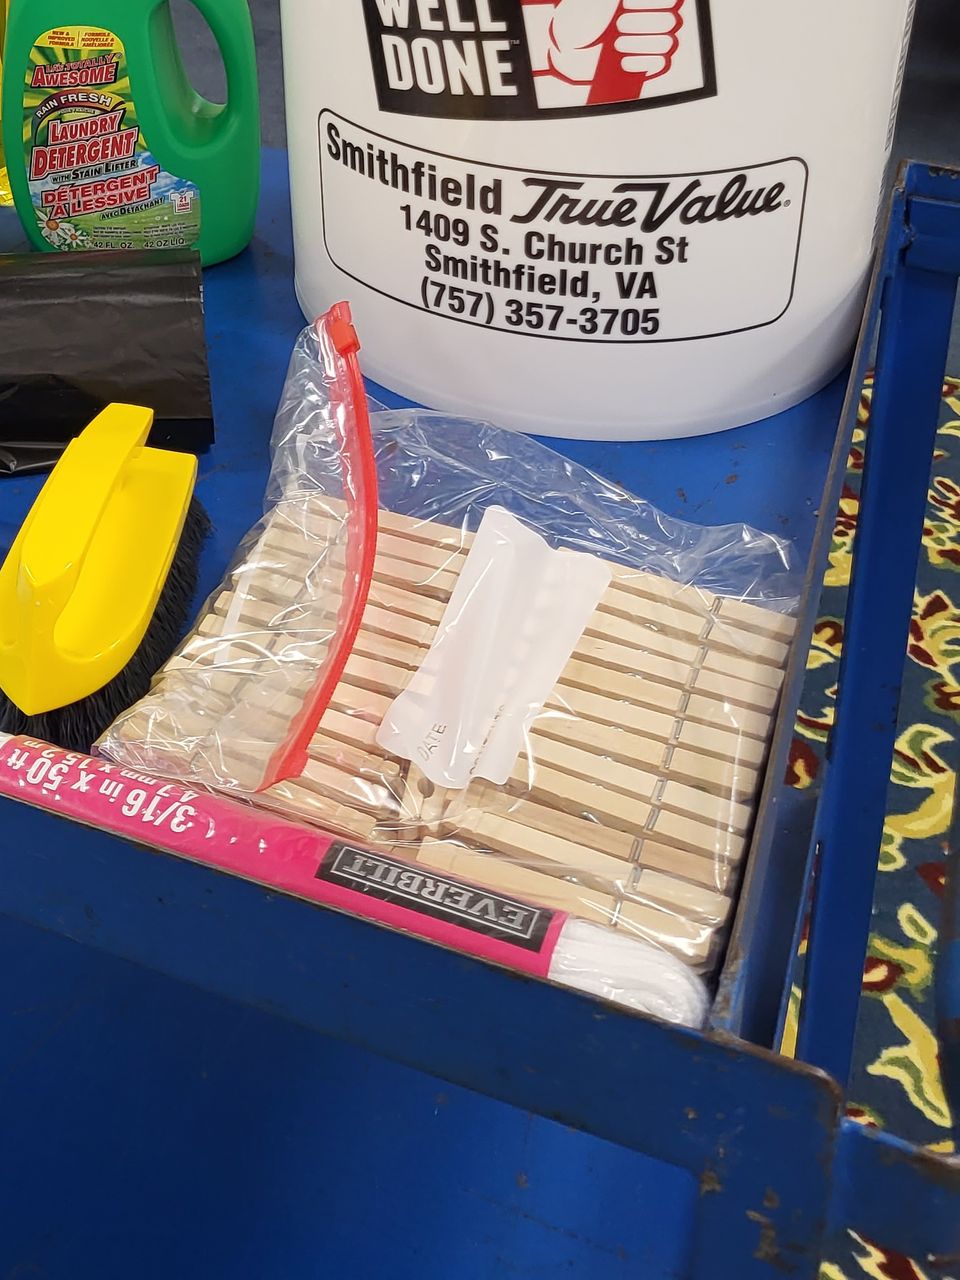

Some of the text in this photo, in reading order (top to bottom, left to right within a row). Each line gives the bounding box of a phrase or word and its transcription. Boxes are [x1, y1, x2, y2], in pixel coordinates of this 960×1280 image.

[31, 63, 117, 87] AWESOME
[65, 53, 115, 71] TOTALLY
[380, 33, 519, 98] DONE
[36, 99, 59, 118] RAIN
[60, 93, 113, 107] FRESH
[50, 113, 119, 143] LAUNDRY
[33, 129, 136, 178] DETERGENT
[51, 160, 137, 183] WITH STAIN LIFTER
[325, 122, 503, 216] Smithfield
[43, 167, 159, 205] DÉTERGENT
[71, 186, 149, 214] LESSIVE
[100, 211, 119, 220] AVEC
[398, 203, 689, 266] 1409 S. Church St
[424, 243, 658, 303] Smithfield, VA
[419, 276, 660, 336] (757) 357-3705
[6, 748, 30, 771] ft
[416, 723, 448, 762] DATE
[25, 757, 71, 792] 50
[98, 778, 126, 804] in
[121, 787, 199, 834] 3/16
[342, 853, 529, 931] EVERBILT
